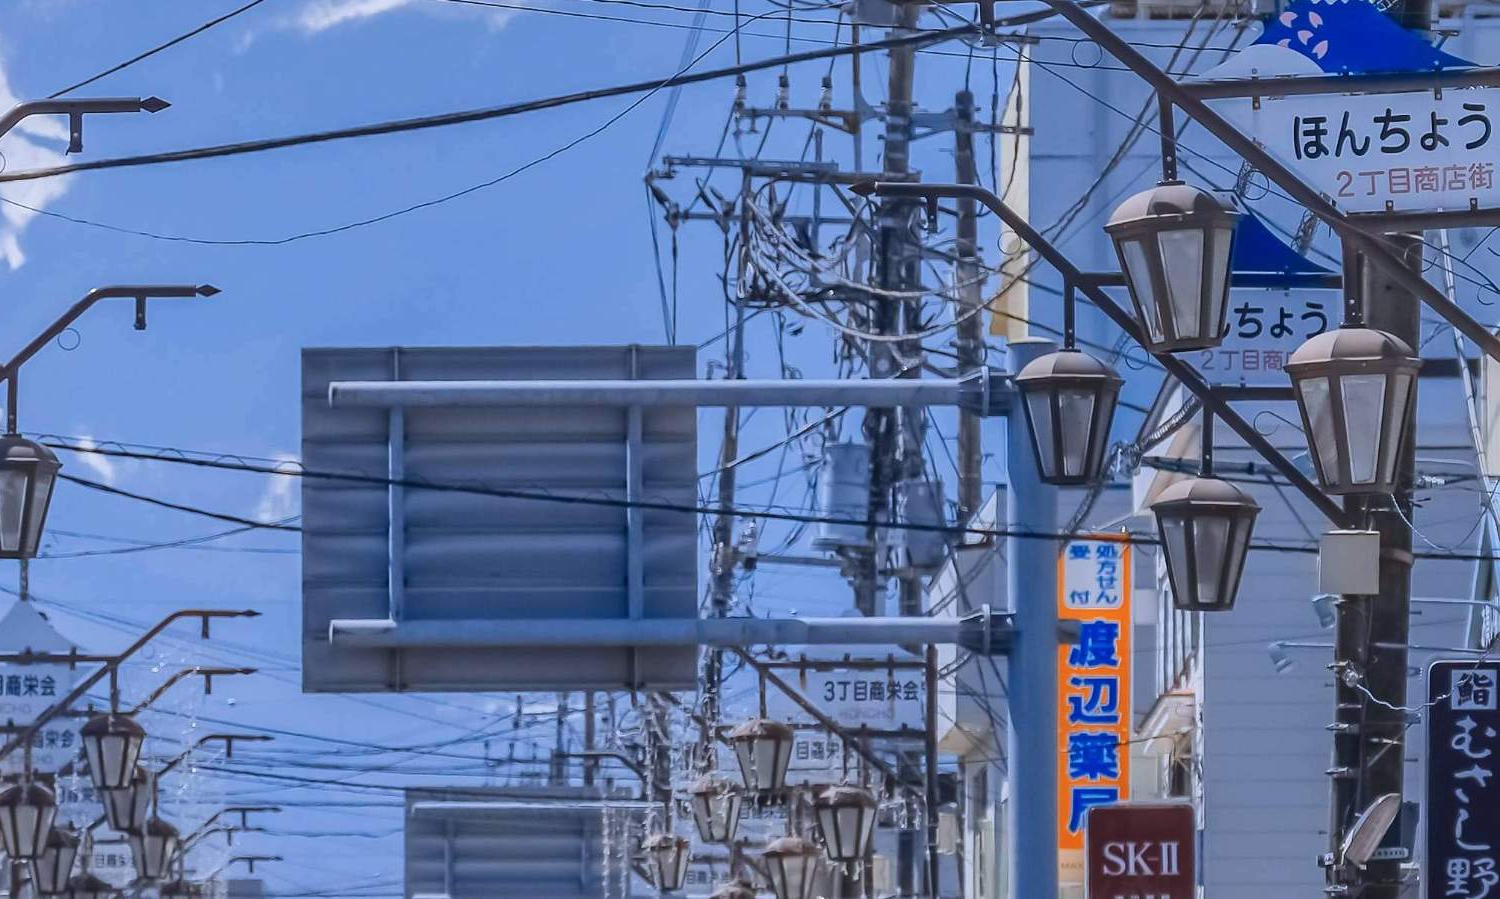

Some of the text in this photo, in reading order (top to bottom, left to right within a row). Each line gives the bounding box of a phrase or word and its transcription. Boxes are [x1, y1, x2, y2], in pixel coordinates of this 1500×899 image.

[1293, 103, 1492, 160] ほんちょう
[1336, 163, 1494, 197] 2丁目商店街
[1222, 302, 1327, 340] ちょう
[1201, 350, 1293, 371] 2丁目商
[824, 680, 918, 702] 3丁目商栄会
[1103, 841, 1180, 876] SK-II
